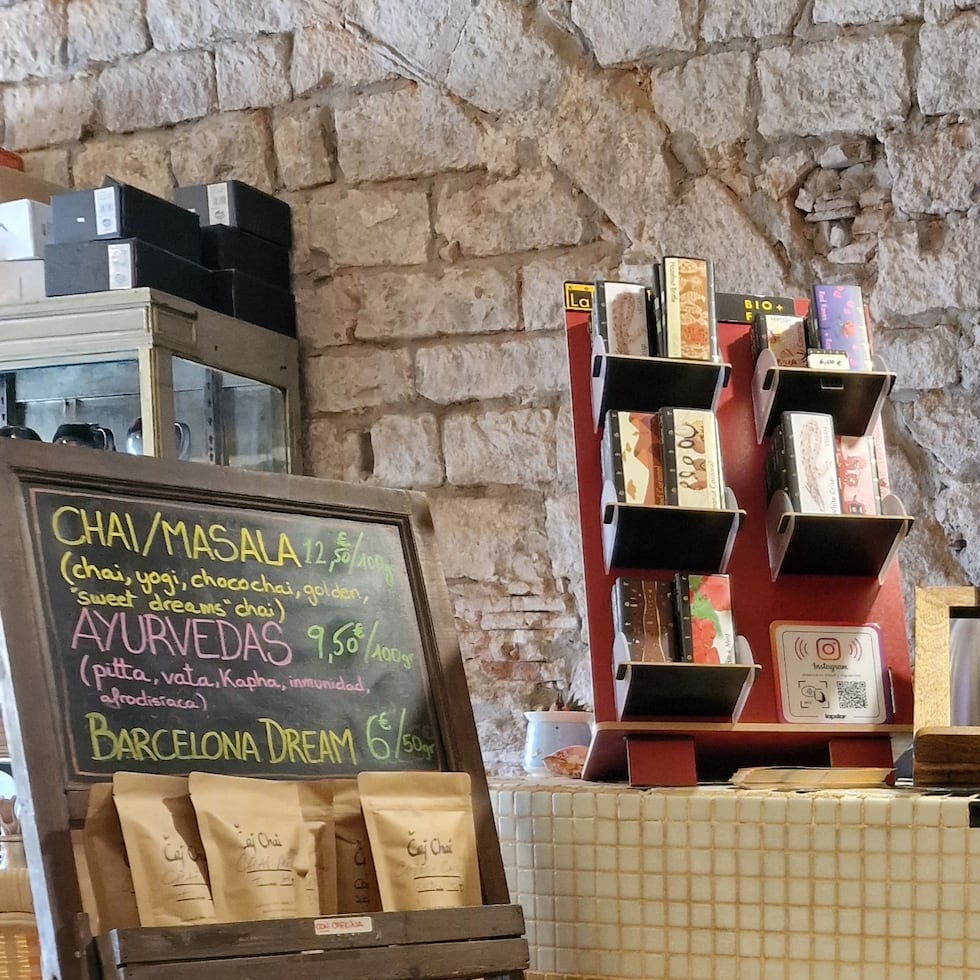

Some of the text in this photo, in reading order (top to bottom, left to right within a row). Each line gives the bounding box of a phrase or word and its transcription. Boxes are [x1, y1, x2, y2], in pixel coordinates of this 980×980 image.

[744, 300, 772, 310] BIO
[52, 505, 302, 568] CHAI/MASALA
[135, 570, 188, 597] yogi,
[303, 580, 369, 606] golden,
[235, 597, 286, 624] chai)
[72, 607, 293, 667] AYURVEDAS
[79, 654, 160, 692] (pitta,
[160, 663, 221, 689] vata,
[812, 662, 848, 672] Instagram
[84, 712, 261, 763] BARCELONA
[256, 718, 358, 766] DREAM
